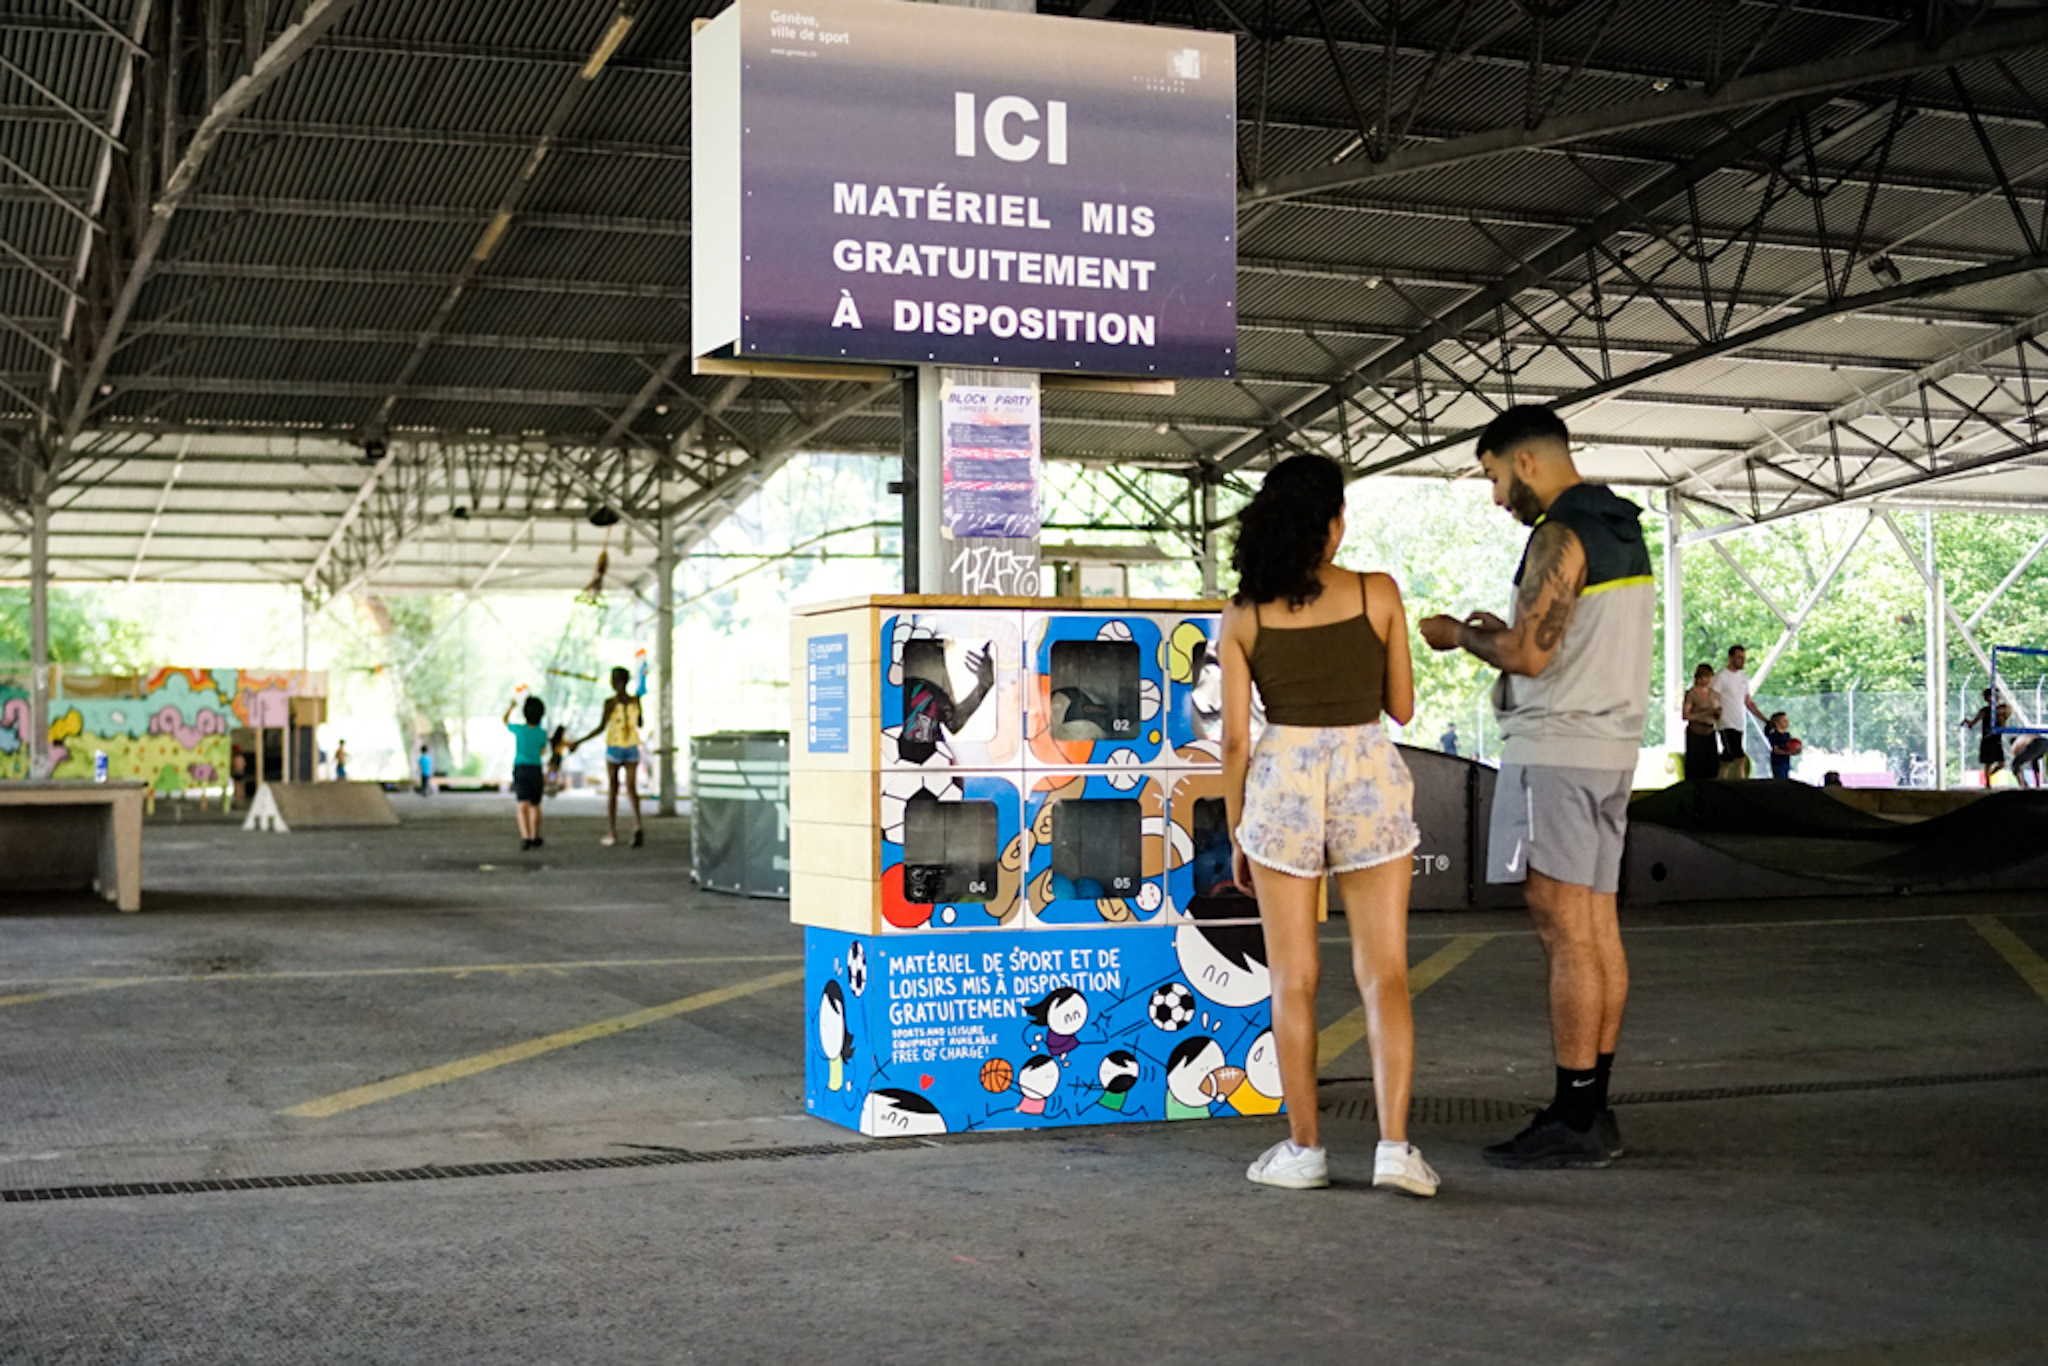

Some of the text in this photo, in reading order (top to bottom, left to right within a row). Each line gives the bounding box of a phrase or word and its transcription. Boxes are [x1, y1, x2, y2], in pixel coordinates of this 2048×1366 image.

[770, 25, 849, 45] ville de sport
[954, 91, 1067, 165] ICI
[833, 181, 1155, 237] MATÉRIEL MIS
[832, 239, 1156, 291] GRATUITEMENT
[831, 289, 1155, 346] À DISPOSITION
[948, 393, 1033, 406] BLOCK PARTY
[1113, 718, 1130, 732] 02
[968, 881, 987, 893] 04
[1113, 877, 1131, 889] 05
[889, 948, 1120, 976] MATÉRIEL DE SPORT ET DE
[889, 970, 1120, 999] LOISIRS MIS À DISPOSITION
[889, 997, 1031, 1026] GRATUITEMENT
[891, 1025, 985, 1039] SPORTS AND LEISURE
[892, 1033, 998, 1049] EQUIPMENT AVAILABLE
[892, 1045, 990, 1065] FREE OF CHARGE!
